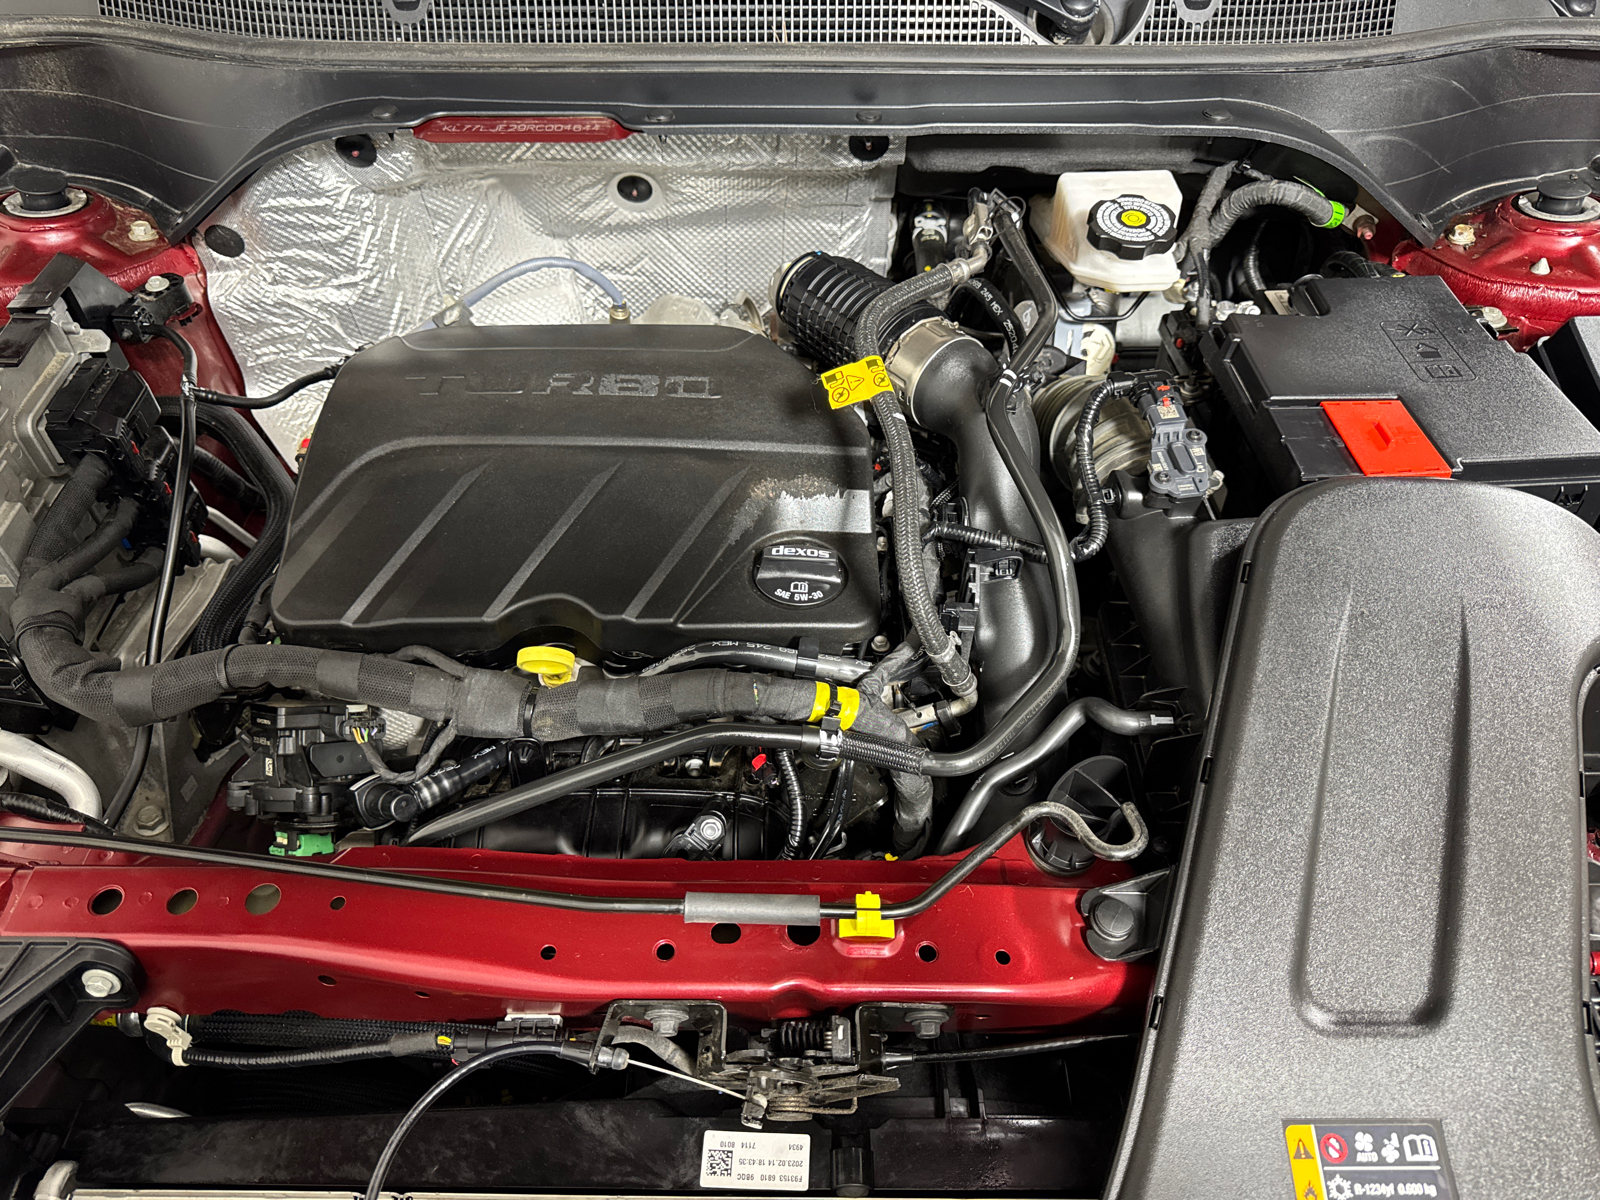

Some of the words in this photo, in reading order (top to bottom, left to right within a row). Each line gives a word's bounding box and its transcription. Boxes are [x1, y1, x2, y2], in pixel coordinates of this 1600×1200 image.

[442, 124, 600, 132] KL77LJE29RC004644
[980, 287, 993, 302] 245
[990, 301, 1003, 316] MEX
[771, 545, 832, 558] dexos
[774, 588, 791, 599] SAE
[794, 590, 824, 601] 5W-30
[746, 641, 771, 650] 245
[720, 1141, 736, 1149] 8010
[741, 1142, 756, 1150] 7114
[788, 1143, 804, 1151] 4934
[1356, 1151, 1378, 1163] AUTO
[738, 1158, 766, 1166] 18:43:35
[768, 1159, 804, 1168] 2023.02.14
[760, 1173, 776, 1182] 6810
[779, 1174, 803, 1183] F93153
